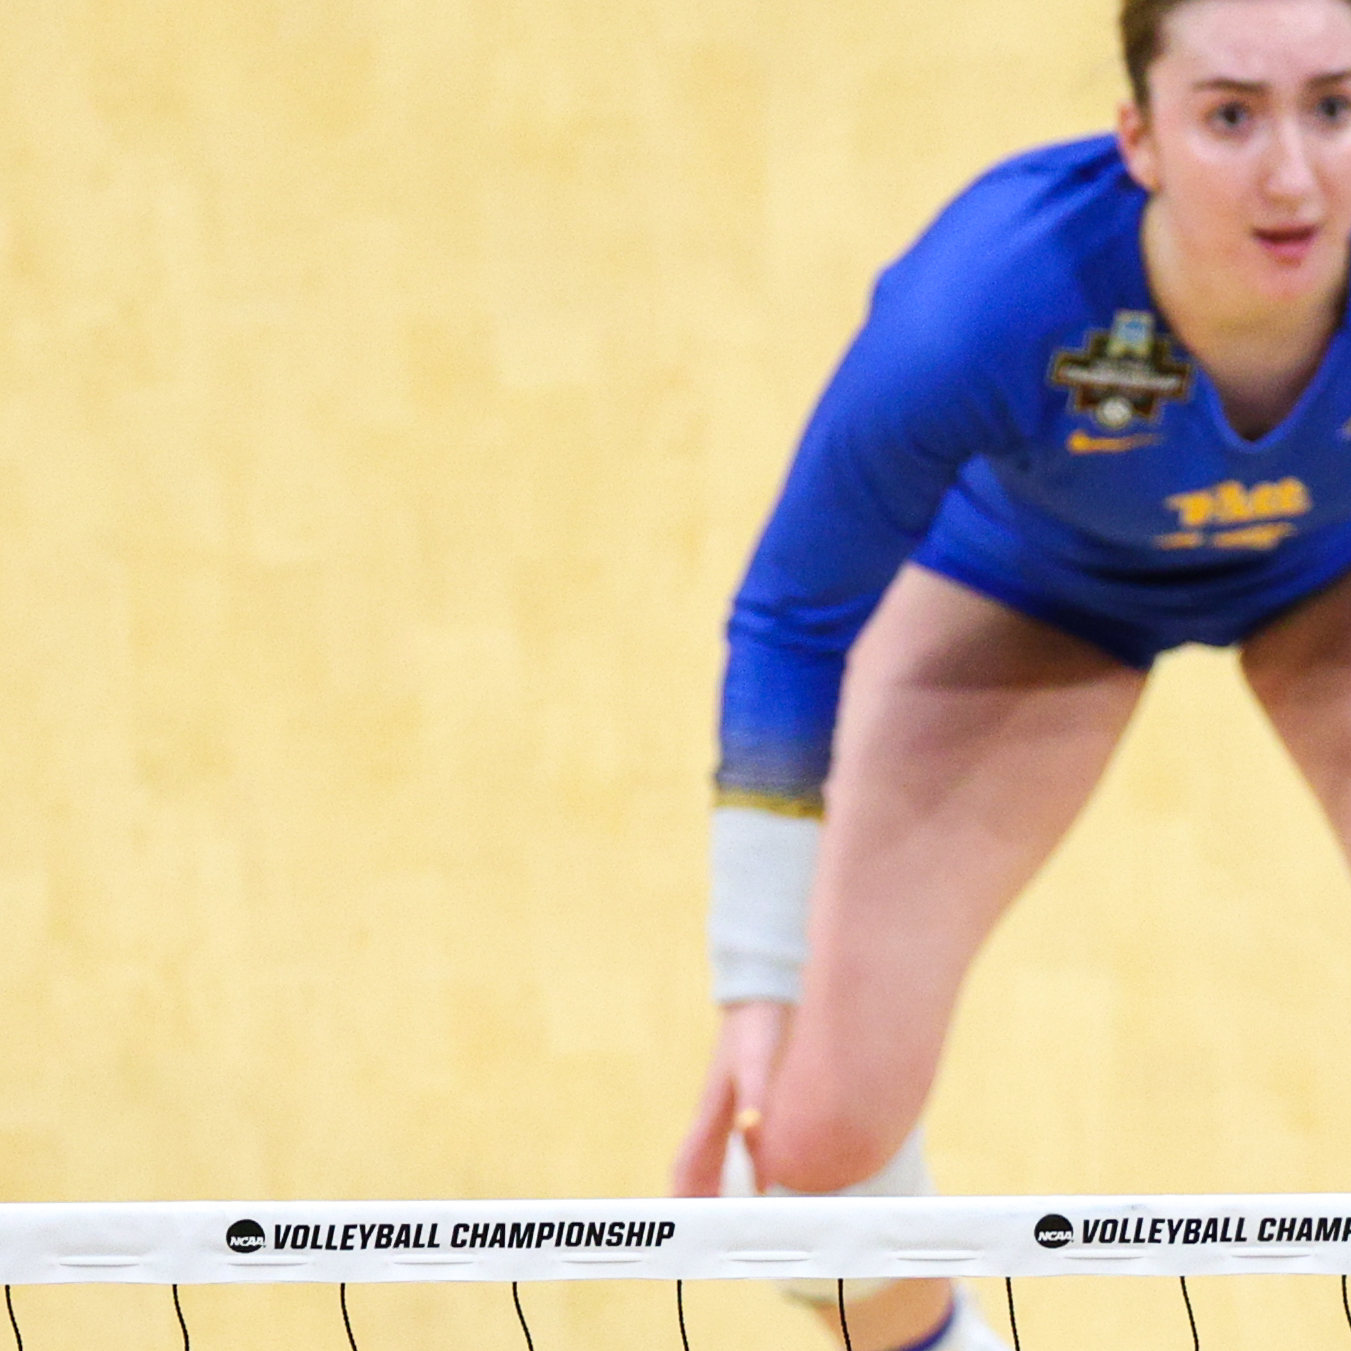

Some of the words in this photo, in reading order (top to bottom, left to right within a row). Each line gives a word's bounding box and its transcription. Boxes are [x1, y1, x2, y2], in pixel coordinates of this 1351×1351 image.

[230, 1236, 266, 1246] NCAA
[274, 1223, 440, 1251] VOLLEYBALL
[450, 1221, 676, 1249] CHAMPIONSHIP
[1038, 1231, 1073, 1242] NCAA
[1082, 1217, 1248, 1245] VOLLEYBALL
